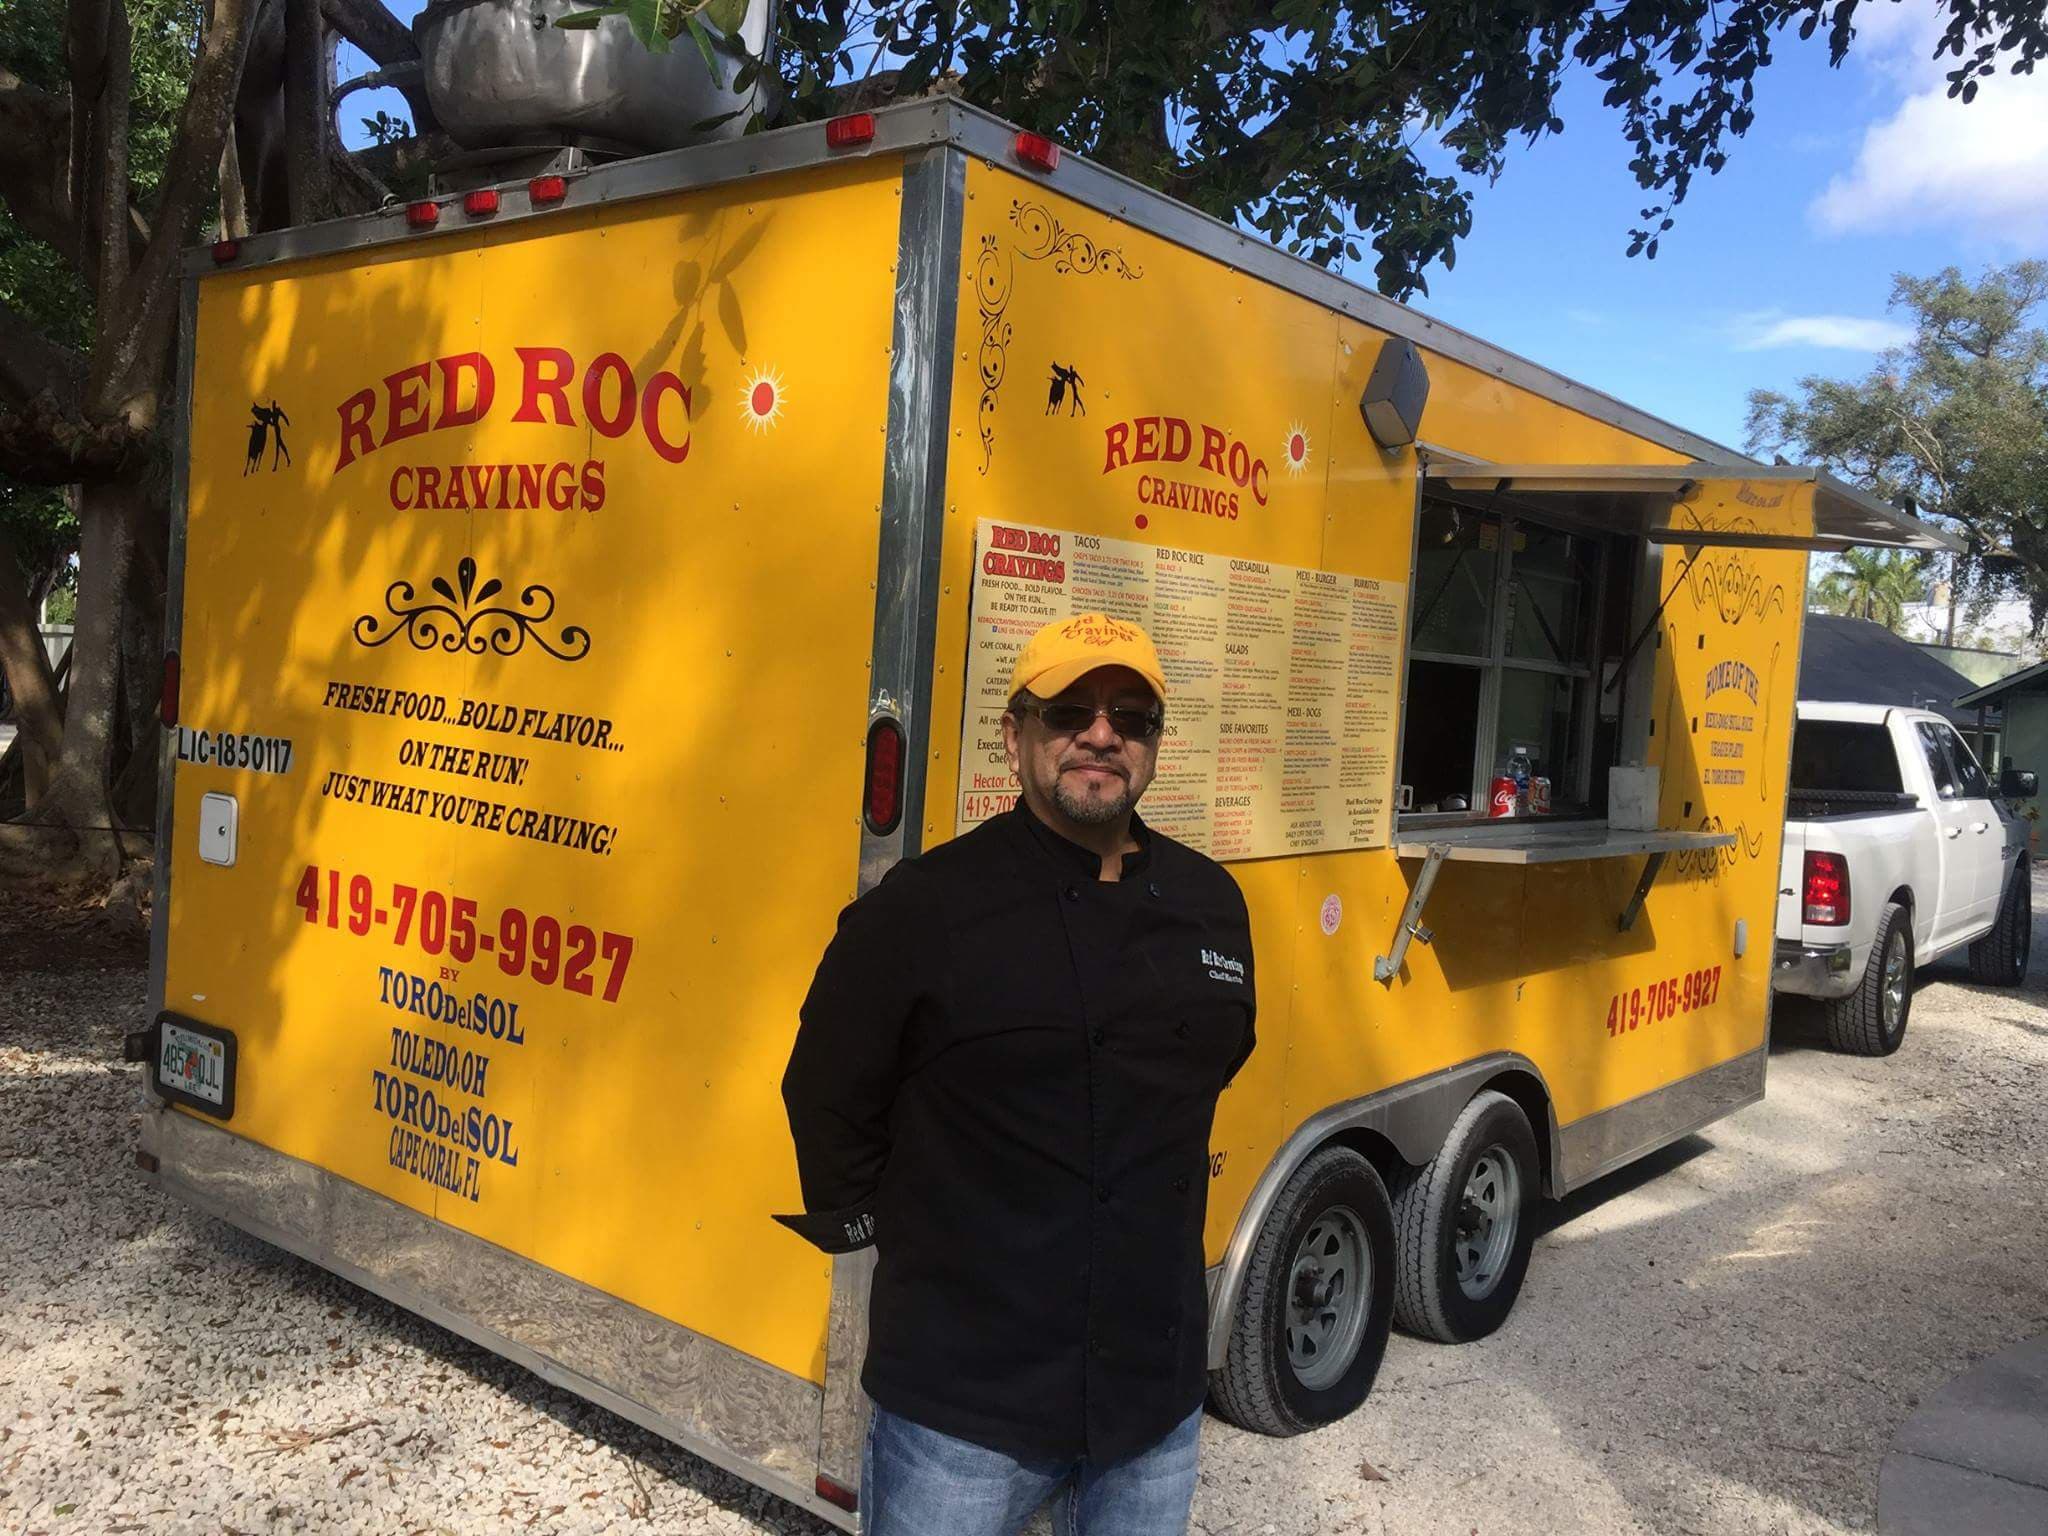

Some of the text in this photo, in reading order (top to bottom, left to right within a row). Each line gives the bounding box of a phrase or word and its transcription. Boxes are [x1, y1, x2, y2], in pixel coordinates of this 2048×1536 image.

[334, 347, 692, 475] RED ROC
[1102, 417, 1270, 507] RED ROC
[390, 460, 606, 511] CRAVINGS
[1138, 476, 1239, 521] CRAVINGS
[991, 525, 1060, 557] RED ROC
[1074, 536, 1100, 550] TACOS
[1156, 548, 1204, 565] RED ROC RICE
[983, 551, 1065, 583] CRAVINGS
[1230, 560, 1270, 575] QUESADILLA
[981, 579, 999, 588] FRESH
[1024, 583, 1040, 593] BOLD
[1004, 593, 1014, 601] ON
[1015, 593, 1027, 602] THE
[990, 602, 998, 610] BE
[1000, 603, 1018, 614] READY
[1020, 605, 1028, 613] TO
[1029, 605, 1048, 615] CRAVE
[980, 641, 994, 650] CAPE
[1225, 643, 1249, 655] SALADS
[986, 677, 1011, 685] CATERIN
[1732, 661, 1745, 689] OF
[981, 688, 1001, 696] PARTIES
[323, 682, 392, 714] FRESH
[518, 709, 625, 752] FLAVOR...
[979, 715, 988, 725] All
[1306, 707, 1322, 718] DOGS
[1163, 725, 1178, 737] HOS
[1220, 723, 1268, 734] SIDE FAVORITES
[399, 738, 529, 786] ON THE RUN!
[973, 773, 1005, 789] Hector
[1215, 796, 1251, 807] BEVERAGES
[322, 772, 617, 856] JUST WHAT YOU'RE CRAVING!
[296, 865, 634, 1003] 419-705-9927
[440, 966, 460, 982] BY
[1607, 965, 1721, 1038] 419-705-9927
[389, 1125, 422, 1175] CAPE
[463, 1156, 480, 1202] FL
[844, 1218, 866, 1244] Red
